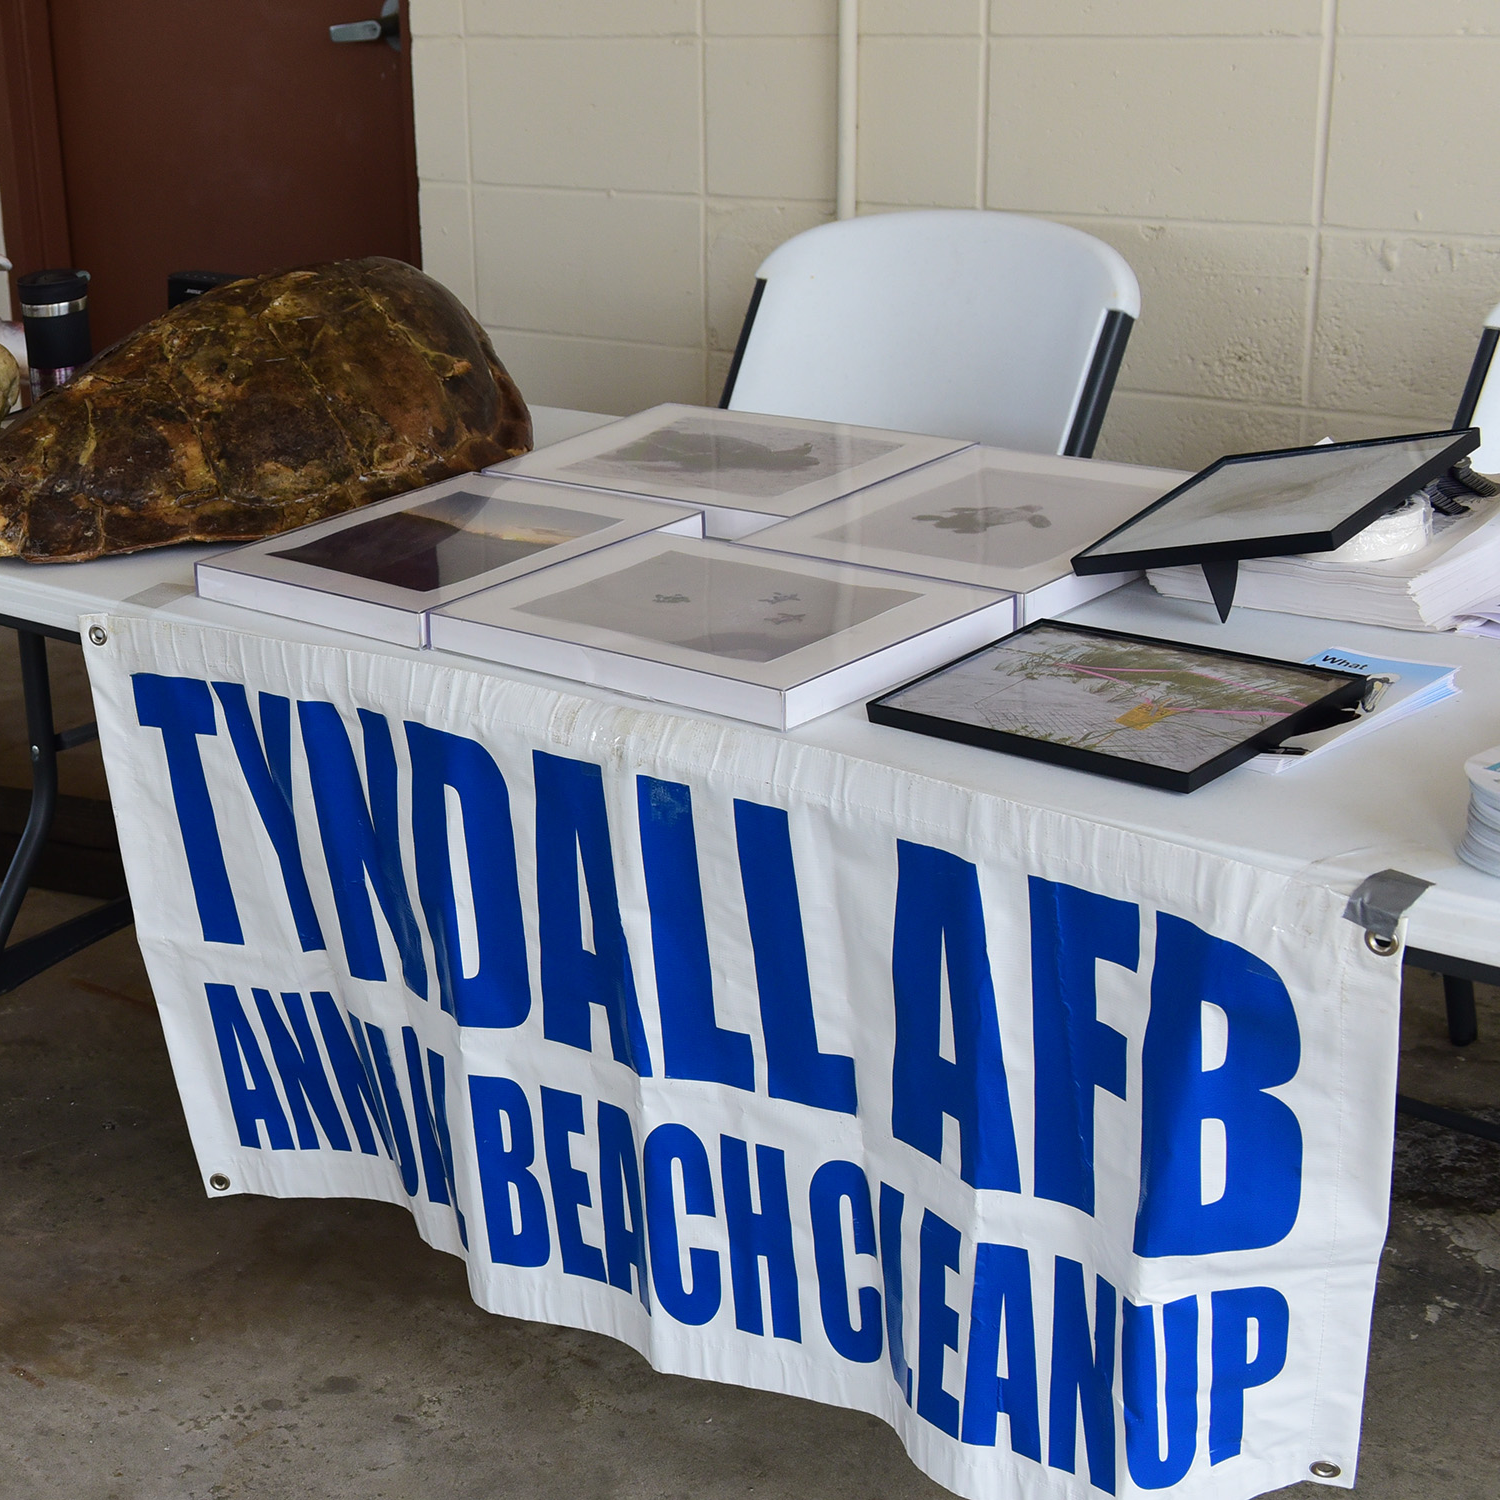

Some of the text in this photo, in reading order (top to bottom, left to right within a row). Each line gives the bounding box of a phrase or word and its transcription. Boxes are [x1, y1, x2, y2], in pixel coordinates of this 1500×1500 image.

[1321, 654, 1368, 670] What
[130, 672, 1303, 1258] TYNDALL AFB
[468, 1074, 802, 1344] BEACH
[809, 1159, 1290, 1497] CLEANUP
